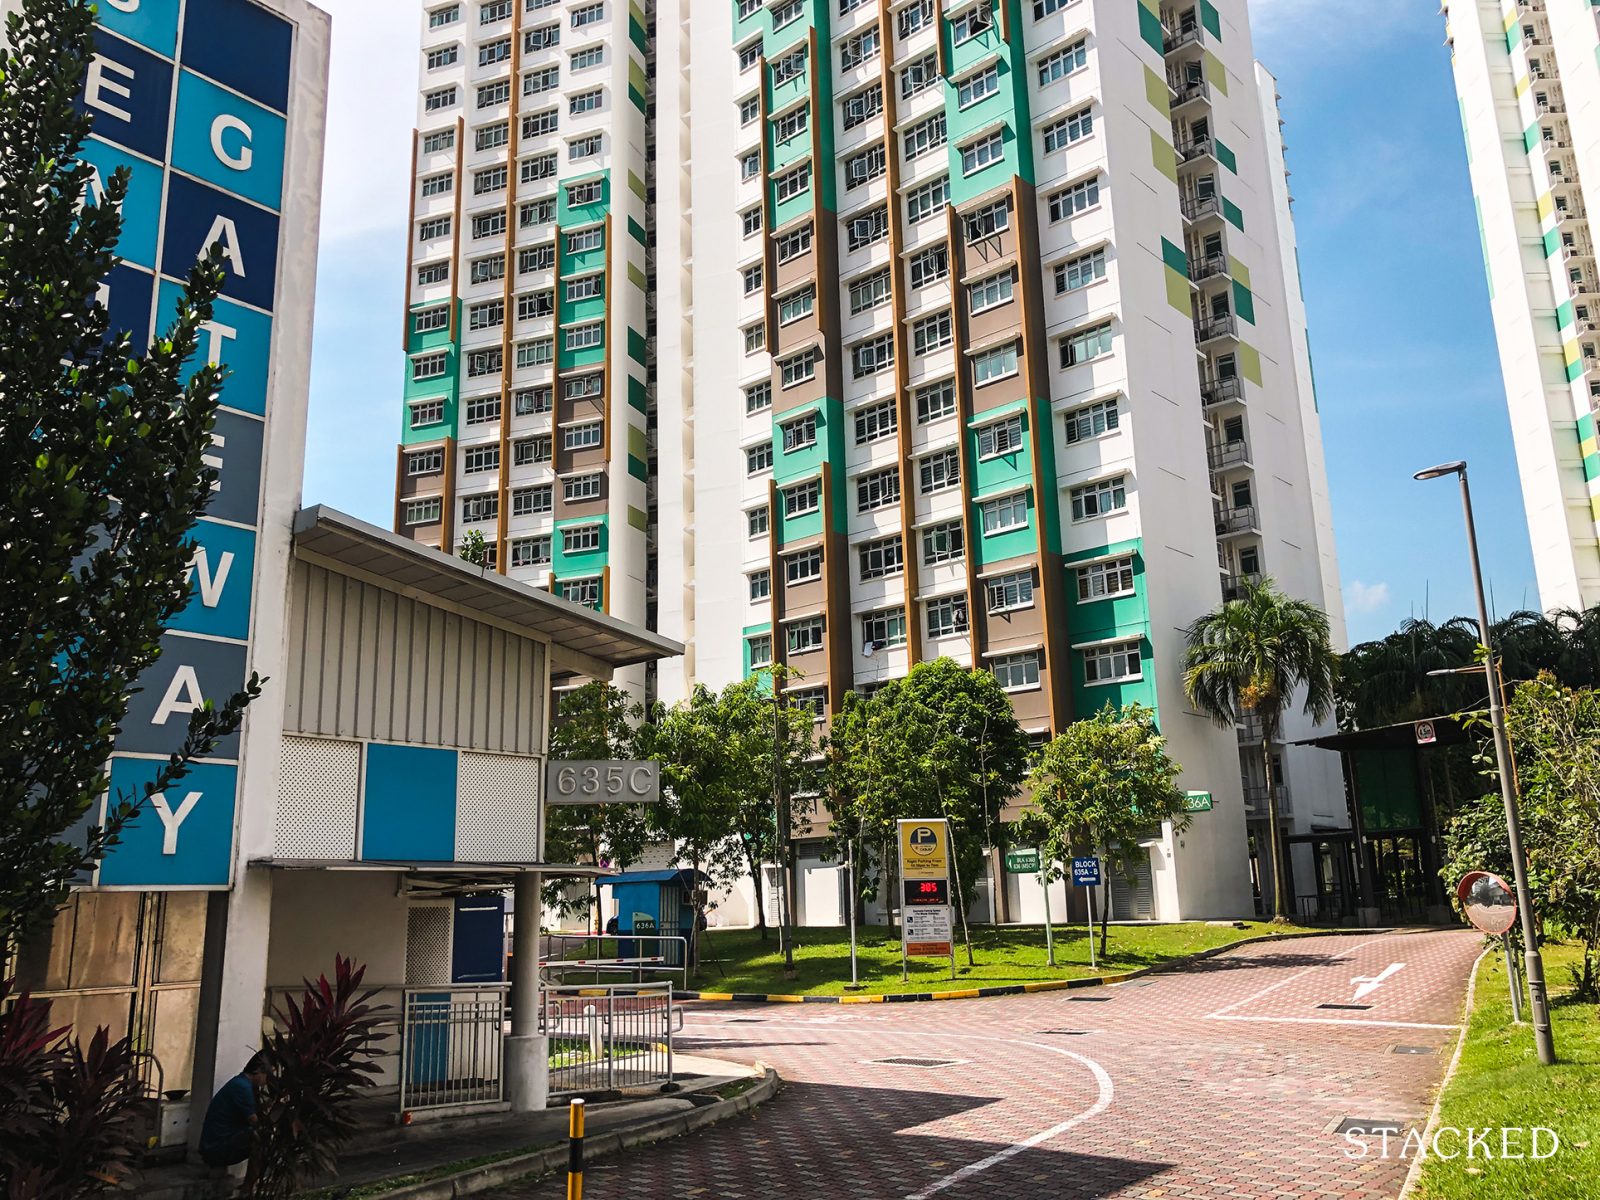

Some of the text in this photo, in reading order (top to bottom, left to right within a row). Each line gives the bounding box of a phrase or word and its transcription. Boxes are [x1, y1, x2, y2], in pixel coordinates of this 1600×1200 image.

[557, 766, 652, 795] 635C
[1182, 796, 1211, 809] 36A
[917, 828, 931, 843] P
[1074, 860, 1097, 868] BLOCK
[1074, 868, 1089, 876] 635A
